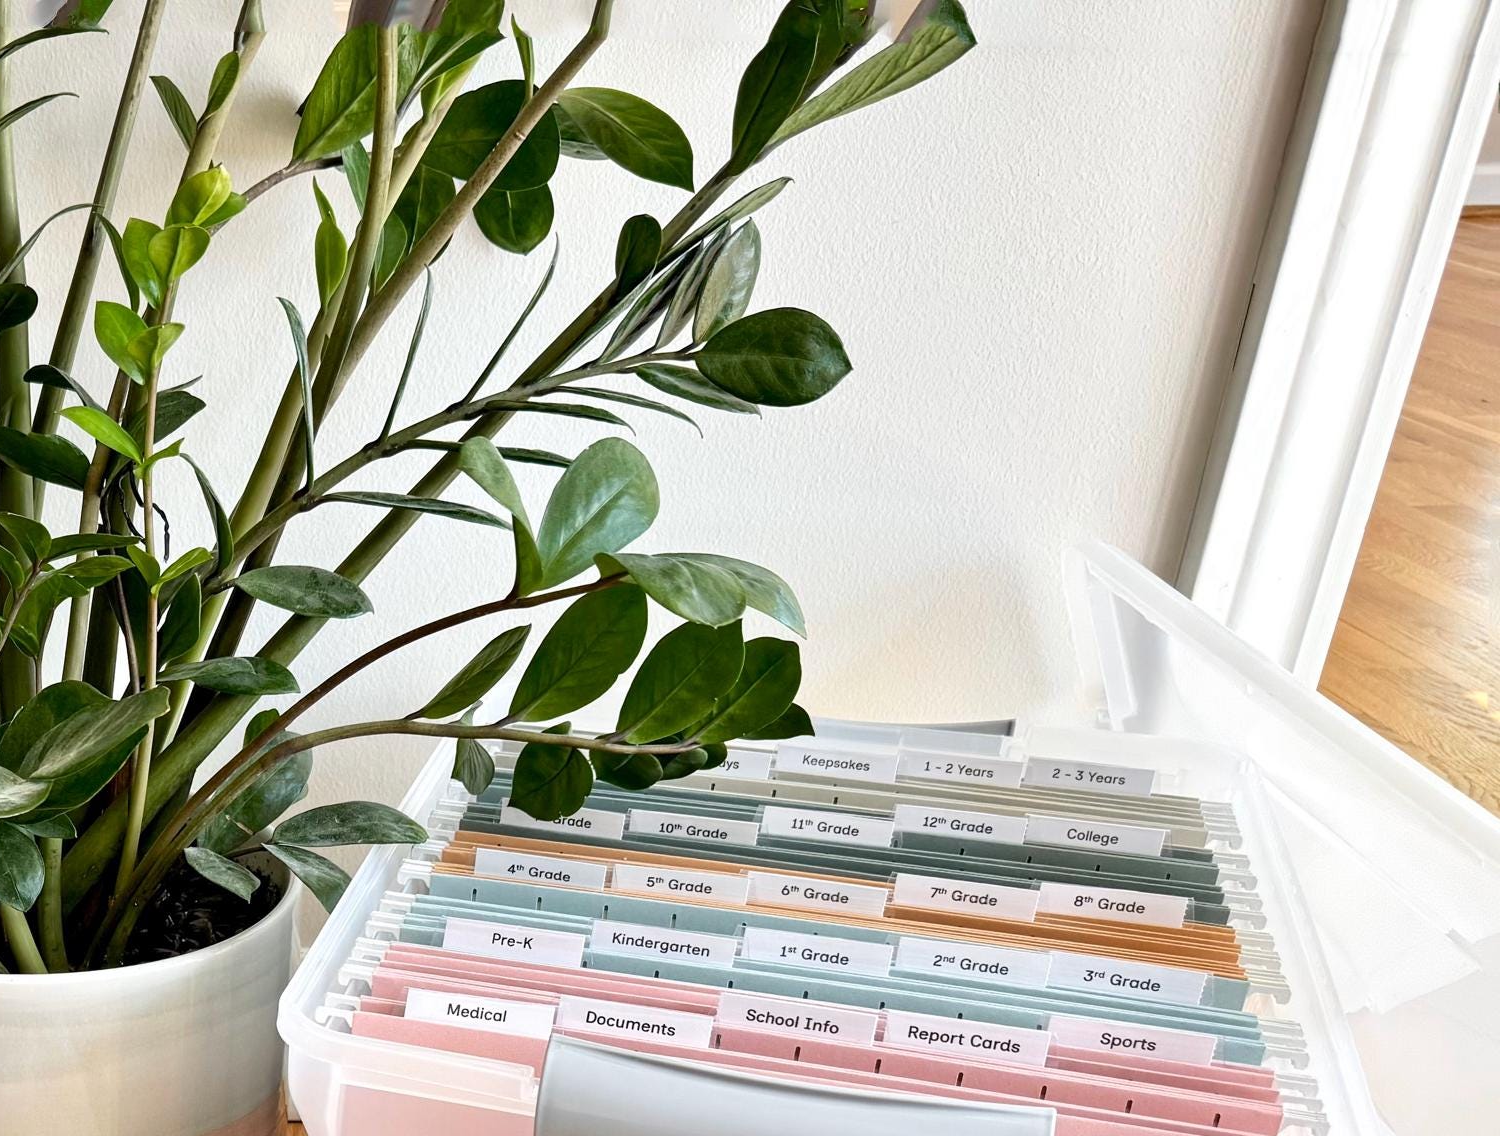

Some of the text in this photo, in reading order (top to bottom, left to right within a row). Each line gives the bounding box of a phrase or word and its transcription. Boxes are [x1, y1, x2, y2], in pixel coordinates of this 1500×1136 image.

[802, 754, 870, 772] Keepsakes
[925, 761, 930, 772] 1
[945, 763, 954, 774] 2
[957, 764, 994, 779] Years
[1052, 768, 1061, 779] 2
[1075, 770, 1085, 781] 3
[1088, 771, 1126, 785] Years
[659, 822, 728, 840] 10th Grade
[791, 818, 860, 837] 11th Grade
[922, 816, 993, 835] 12th Grade
[1067, 828, 1119, 847] College
[507, 864, 571, 882] 4th Grade
[646, 876, 713, 894] 5th Grade
[781, 884, 849, 904] 6th Grade
[930, 887, 998, 907] 7th Grade
[1073, 895, 1146, 914] 8th Grade
[491, 932, 533, 950] Pre-K
[612, 932, 710, 957] Kindergarten
[779, 945, 850, 966] 1st Grade
[932, 954, 1009, 976] 2nd Grade
[1083, 969, 1161, 992] 3rd Grade
[447, 1003, 507, 1023] Medical
[745, 1008, 840, 1034] School Info
[585, 1010, 676, 1037] Documents
[907, 1025, 1021, 1054] Report Cards
[1099, 1032, 1157, 1052] Sports
